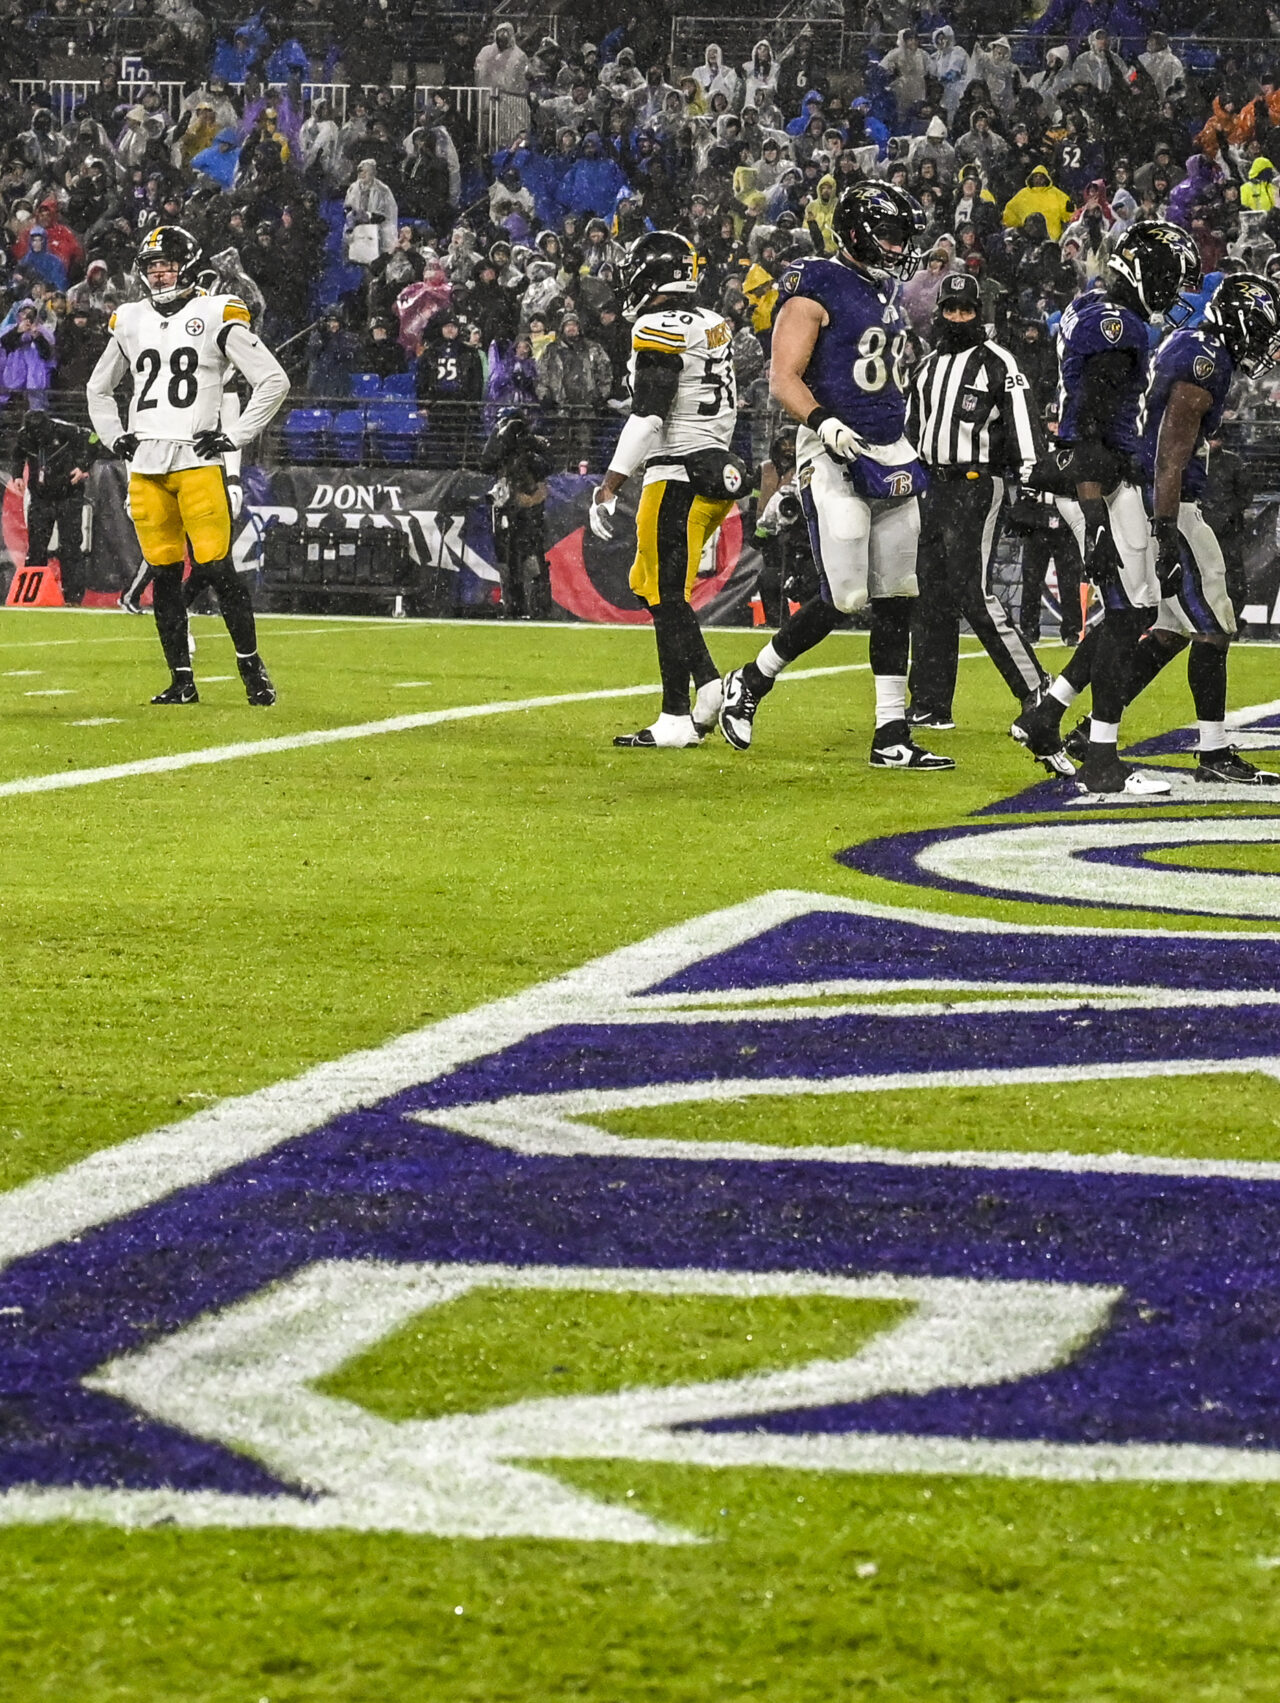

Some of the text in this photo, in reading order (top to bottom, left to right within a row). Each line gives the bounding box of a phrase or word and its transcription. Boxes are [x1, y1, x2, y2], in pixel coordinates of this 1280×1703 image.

[796, 70, 808, 87] 6
[1063, 146, 1081, 168] 52
[135, 346, 199, 412] 28
[437, 358, 458, 380] 55
[1006, 374, 1025, 389] 38
[307, 484, 403, 511] DON'T
[13, 571, 44, 603] 10
